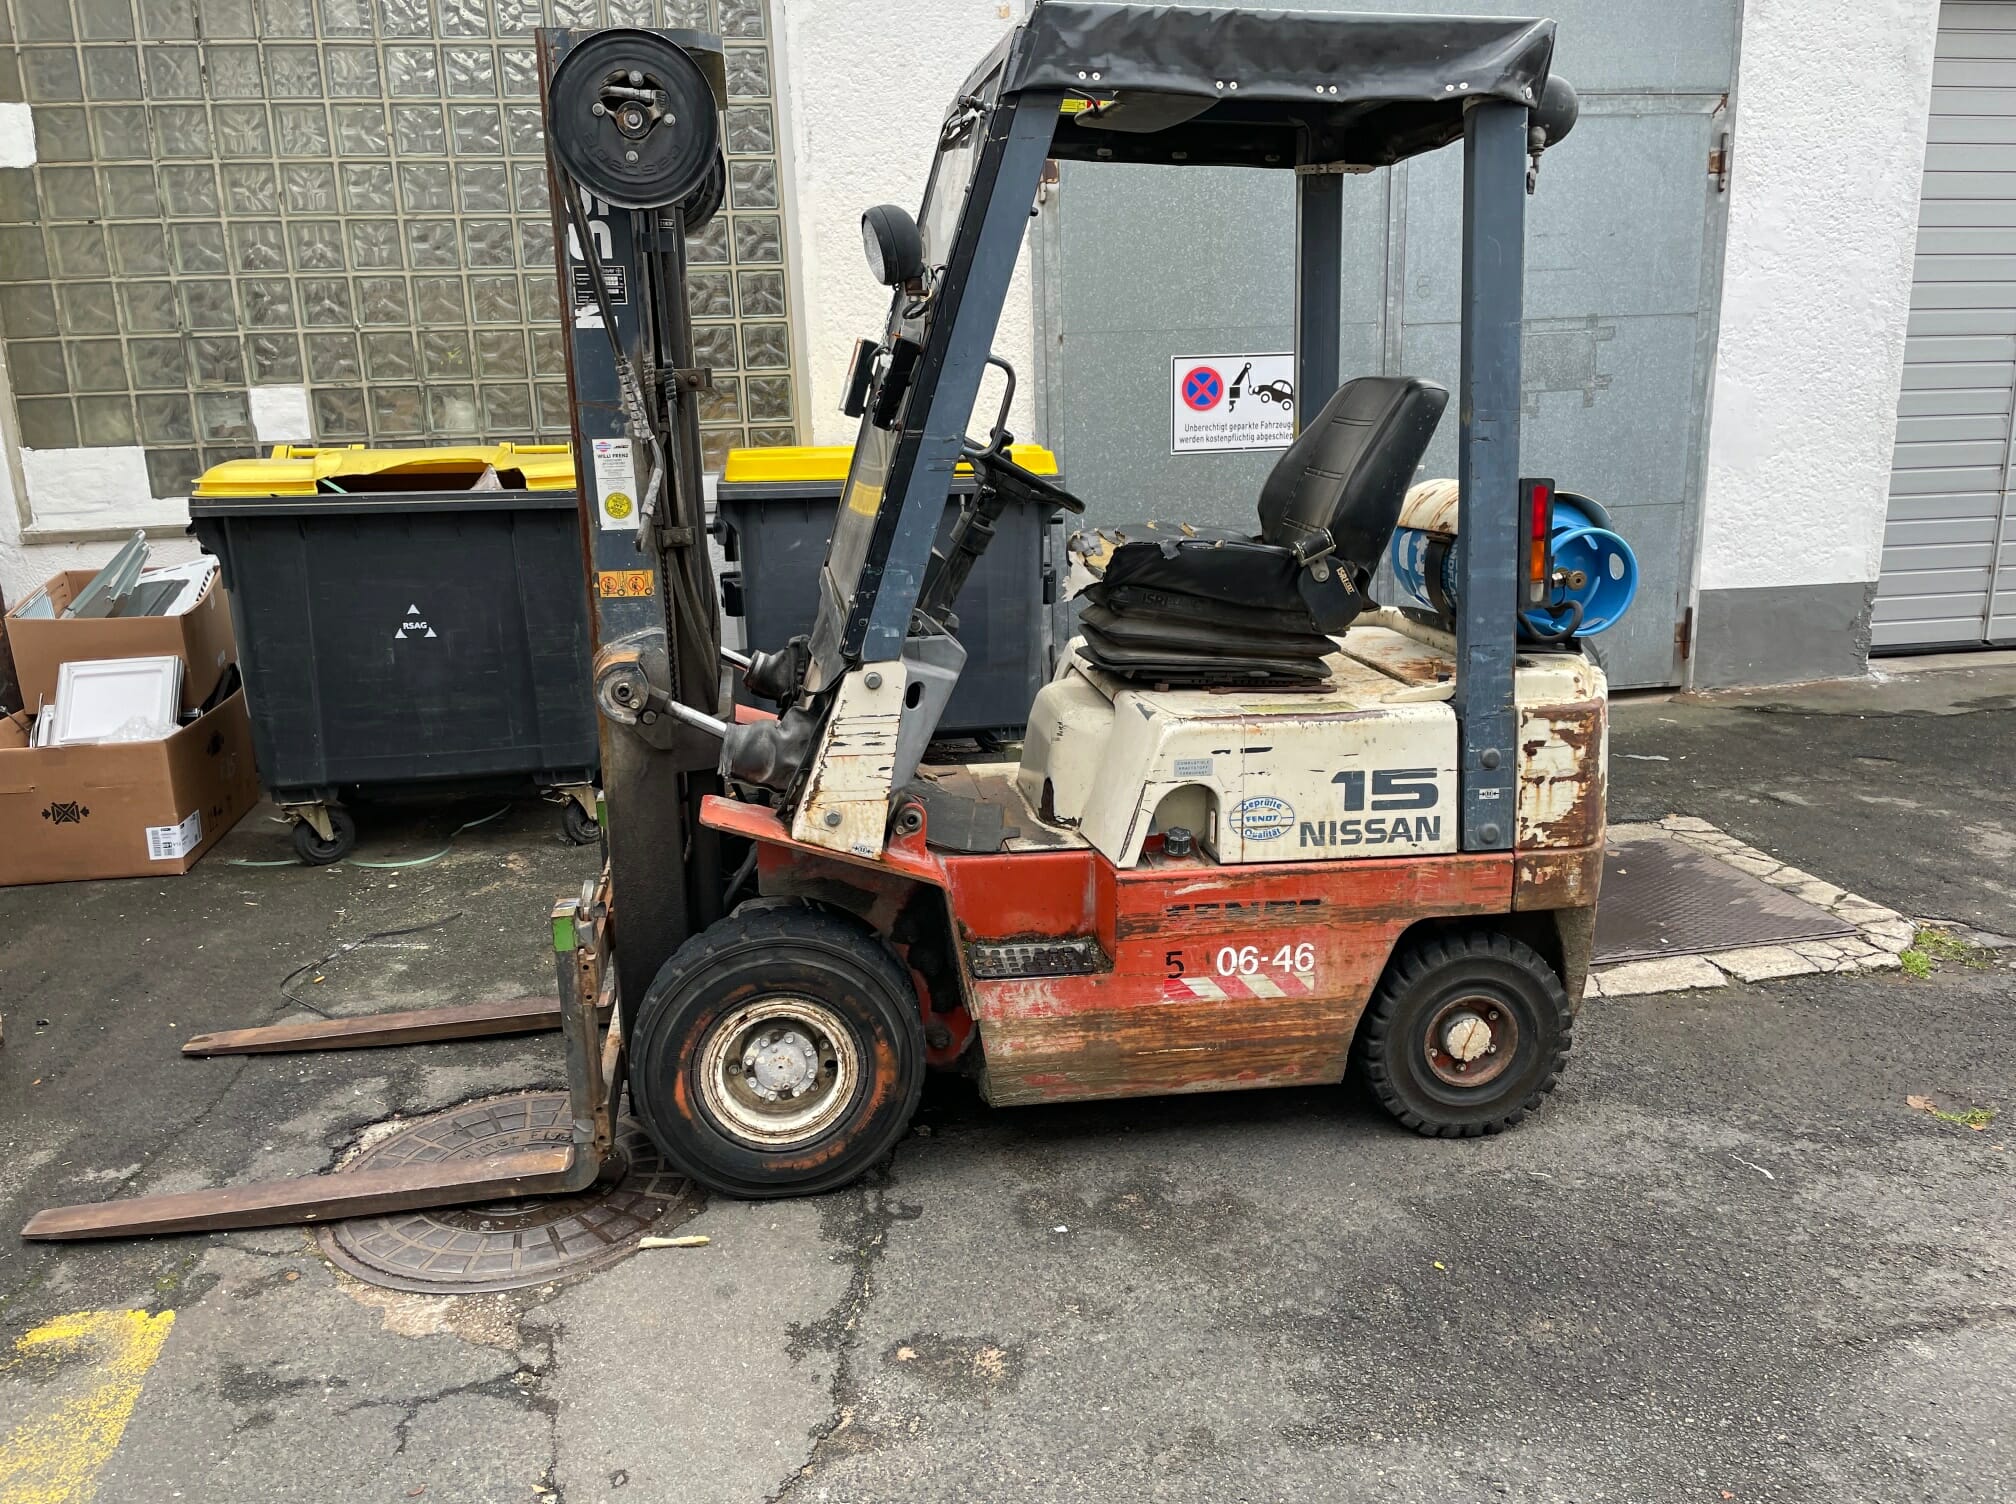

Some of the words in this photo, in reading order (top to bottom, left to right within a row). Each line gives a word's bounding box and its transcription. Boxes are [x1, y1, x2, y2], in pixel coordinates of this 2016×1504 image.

[1184, 422, 1228, 433] Unberechtigt
[1229, 421, 1259, 432] geparkte
[1260, 420, 1293, 430] Fahrzeug
[1179, 434, 1205, 444] werden
[1205, 432, 1255, 444] kostenpflichtig
[402, 621, 427, 630] RSAG
[1332, 768, 1439, 812] 15
[1241, 799, 1283, 811] Geprüfte
[1299, 815, 1441, 847] NISSAN
[1165, 951, 1185, 979] 5
[1216, 942, 1315, 976] 06-46
